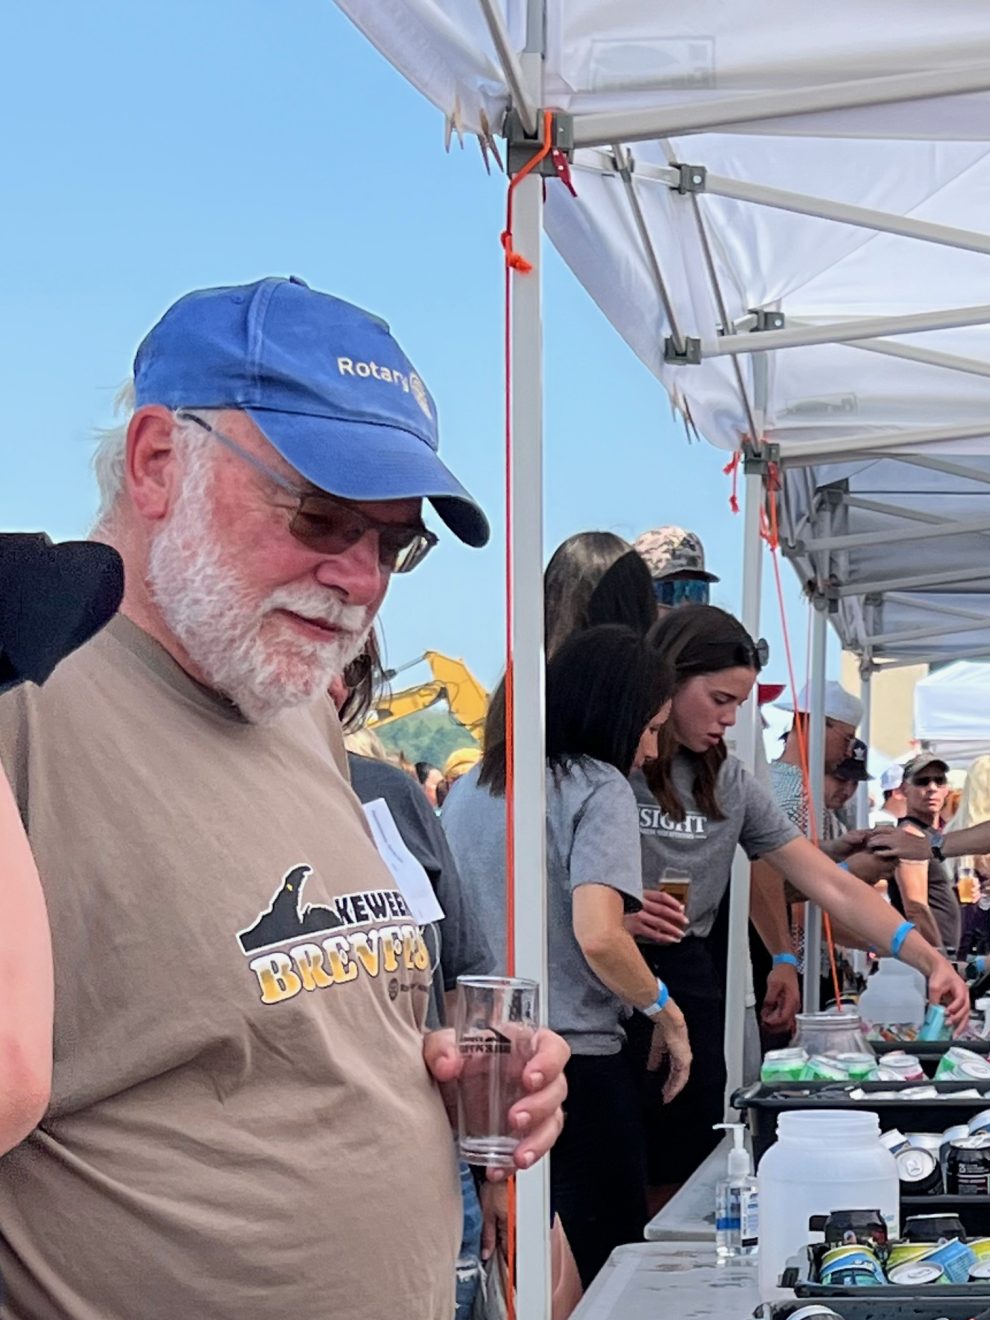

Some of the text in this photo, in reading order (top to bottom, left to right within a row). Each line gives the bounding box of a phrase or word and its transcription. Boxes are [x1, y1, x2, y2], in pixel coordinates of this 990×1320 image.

[337, 357, 409, 392] Rotary
[638, 808, 707, 833] SIGHT
[335, 891, 409, 925] KEWEE
